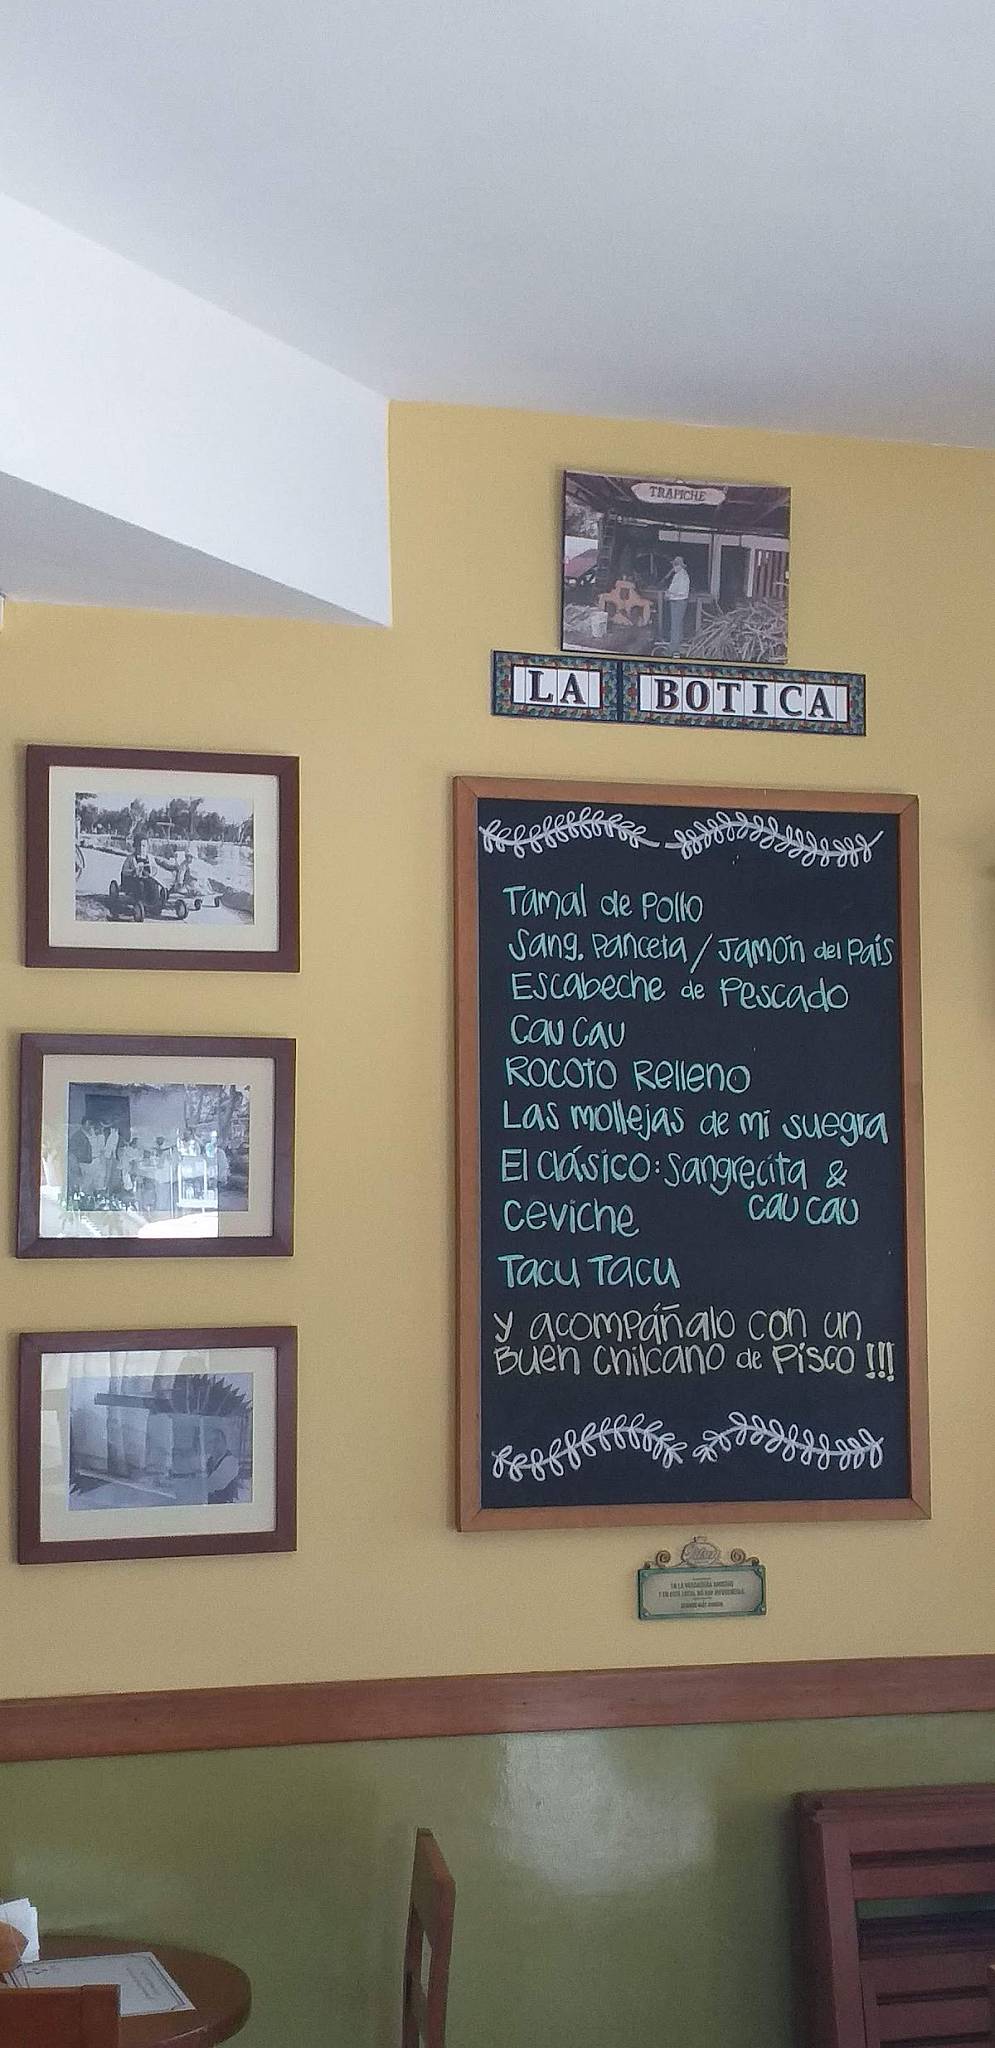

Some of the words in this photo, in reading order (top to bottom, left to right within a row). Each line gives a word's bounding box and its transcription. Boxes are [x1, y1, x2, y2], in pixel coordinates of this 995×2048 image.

[649, 485, 706, 502] TRAPICHE
[528, 670, 586, 705] LA
[654, 678, 834, 719] BOTICA
[503, 883, 587, 919] Tamal
[601, 890, 632, 917] de
[643, 892, 703, 922] Pollo
[509, 929, 583, 961] Sang.
[592, 932, 687, 963] Panceta
[690, 934, 712, 973] /
[718, 935, 805, 966] Jamón
[814, 941, 841, 960] del
[848, 934, 894, 967] País
[512, 970, 665, 1002] Escabeche
[681, 980, 705, 1000] de
[720, 978, 848, 1012] Pescado
[633, 1060, 750, 1093] Relleno
[504, 1100, 559, 1131] Las
[571, 1099, 684, 1141] mollejas
[700, 1111, 729, 1137] de
[782, 1112, 888, 1147] suegra
[502, 1149, 528, 1182] El
[826, 1160, 847, 1188] &
[498, 1255, 580, 1288] Tacu
[587, 1255, 680, 1288] Tacu
[749, 1308, 806, 1341] con
[824, 1311, 861, 1340] un
[493, 1344, 580, 1375] Buen
[736, 1350, 762, 1369] de
[865, 1342, 894, 1382] !!!
